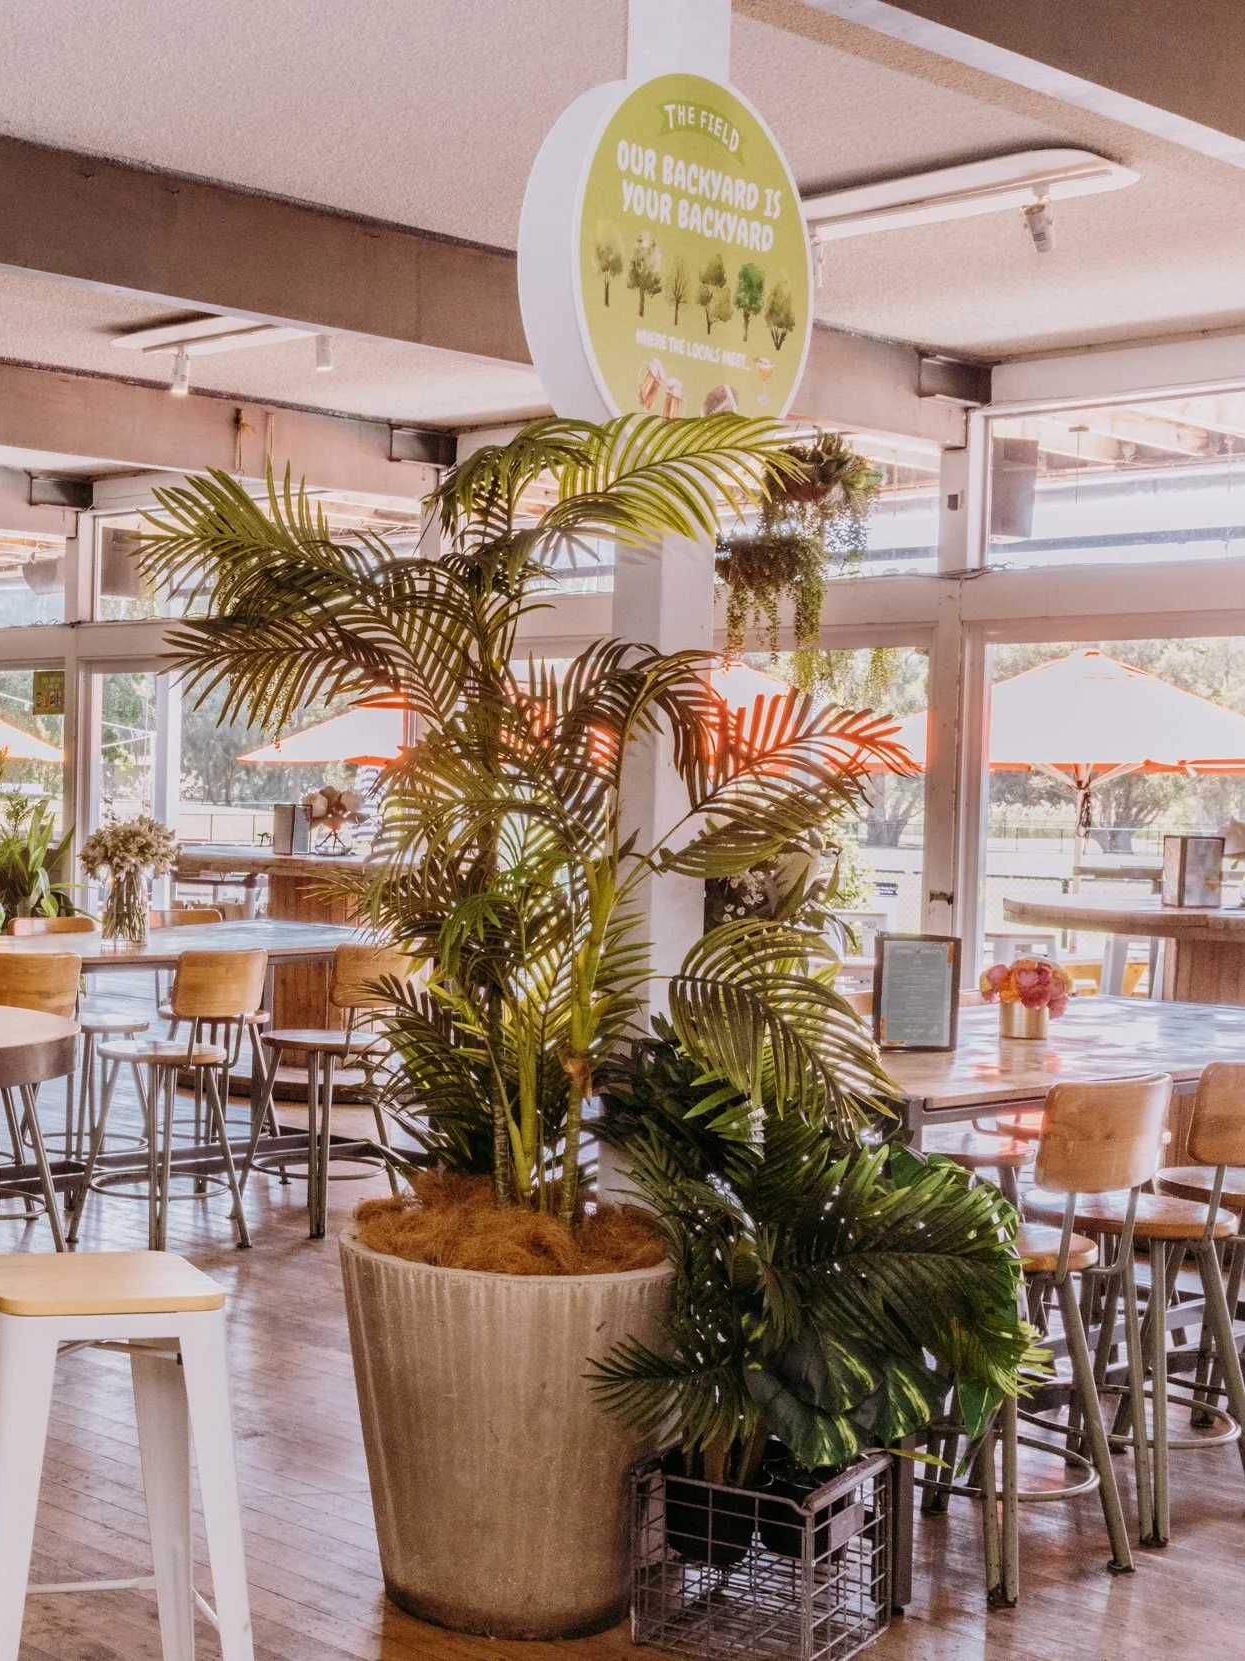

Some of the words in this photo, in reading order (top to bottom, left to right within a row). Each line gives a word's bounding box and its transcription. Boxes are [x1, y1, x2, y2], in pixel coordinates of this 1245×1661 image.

[663, 103, 695, 129] THE
[699, 109, 740, 152] FIELD
[616, 140, 657, 182] OUR
[662, 155, 759, 212] BACKYARD
[764, 188, 783, 220] IS
[622, 179, 673, 225] YOUR
[677, 199, 775, 252] BACKYARD
[636, 328, 667, 351] WHERE
[668, 336, 686, 355] THE
[687, 340, 720, 364] LOCALS
